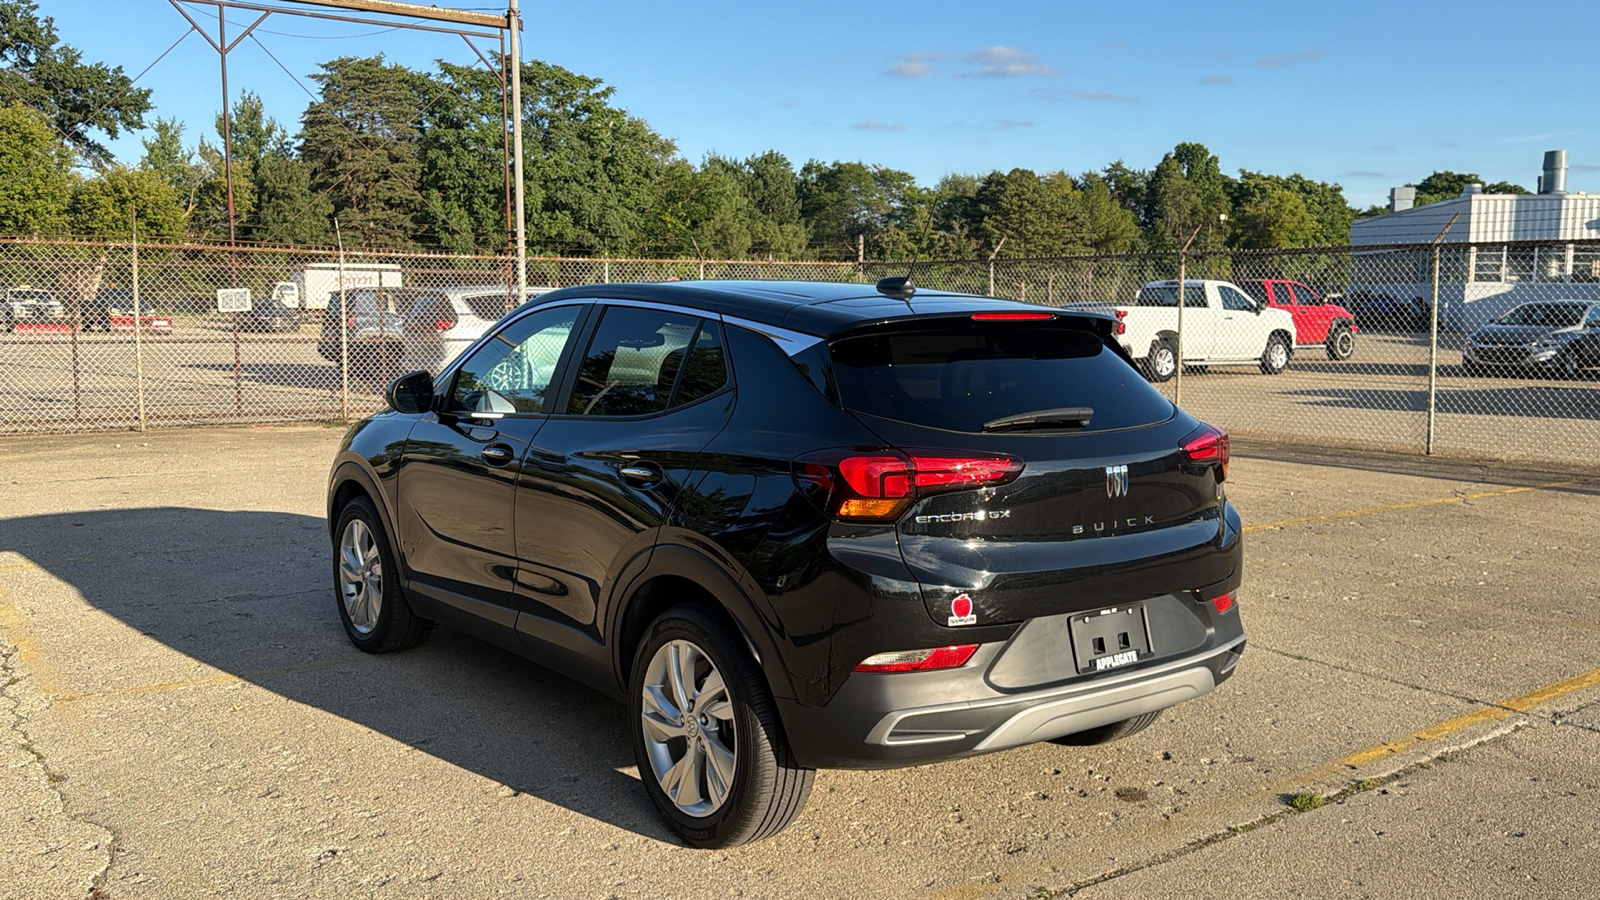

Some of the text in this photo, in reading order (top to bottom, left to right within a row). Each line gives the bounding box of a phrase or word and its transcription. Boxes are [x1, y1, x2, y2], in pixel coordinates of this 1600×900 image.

[988, 510, 1010, 519] GX
[1072, 515, 1154, 534] BUICK
[1096, 650, 1138, 671] APPLEGATE
